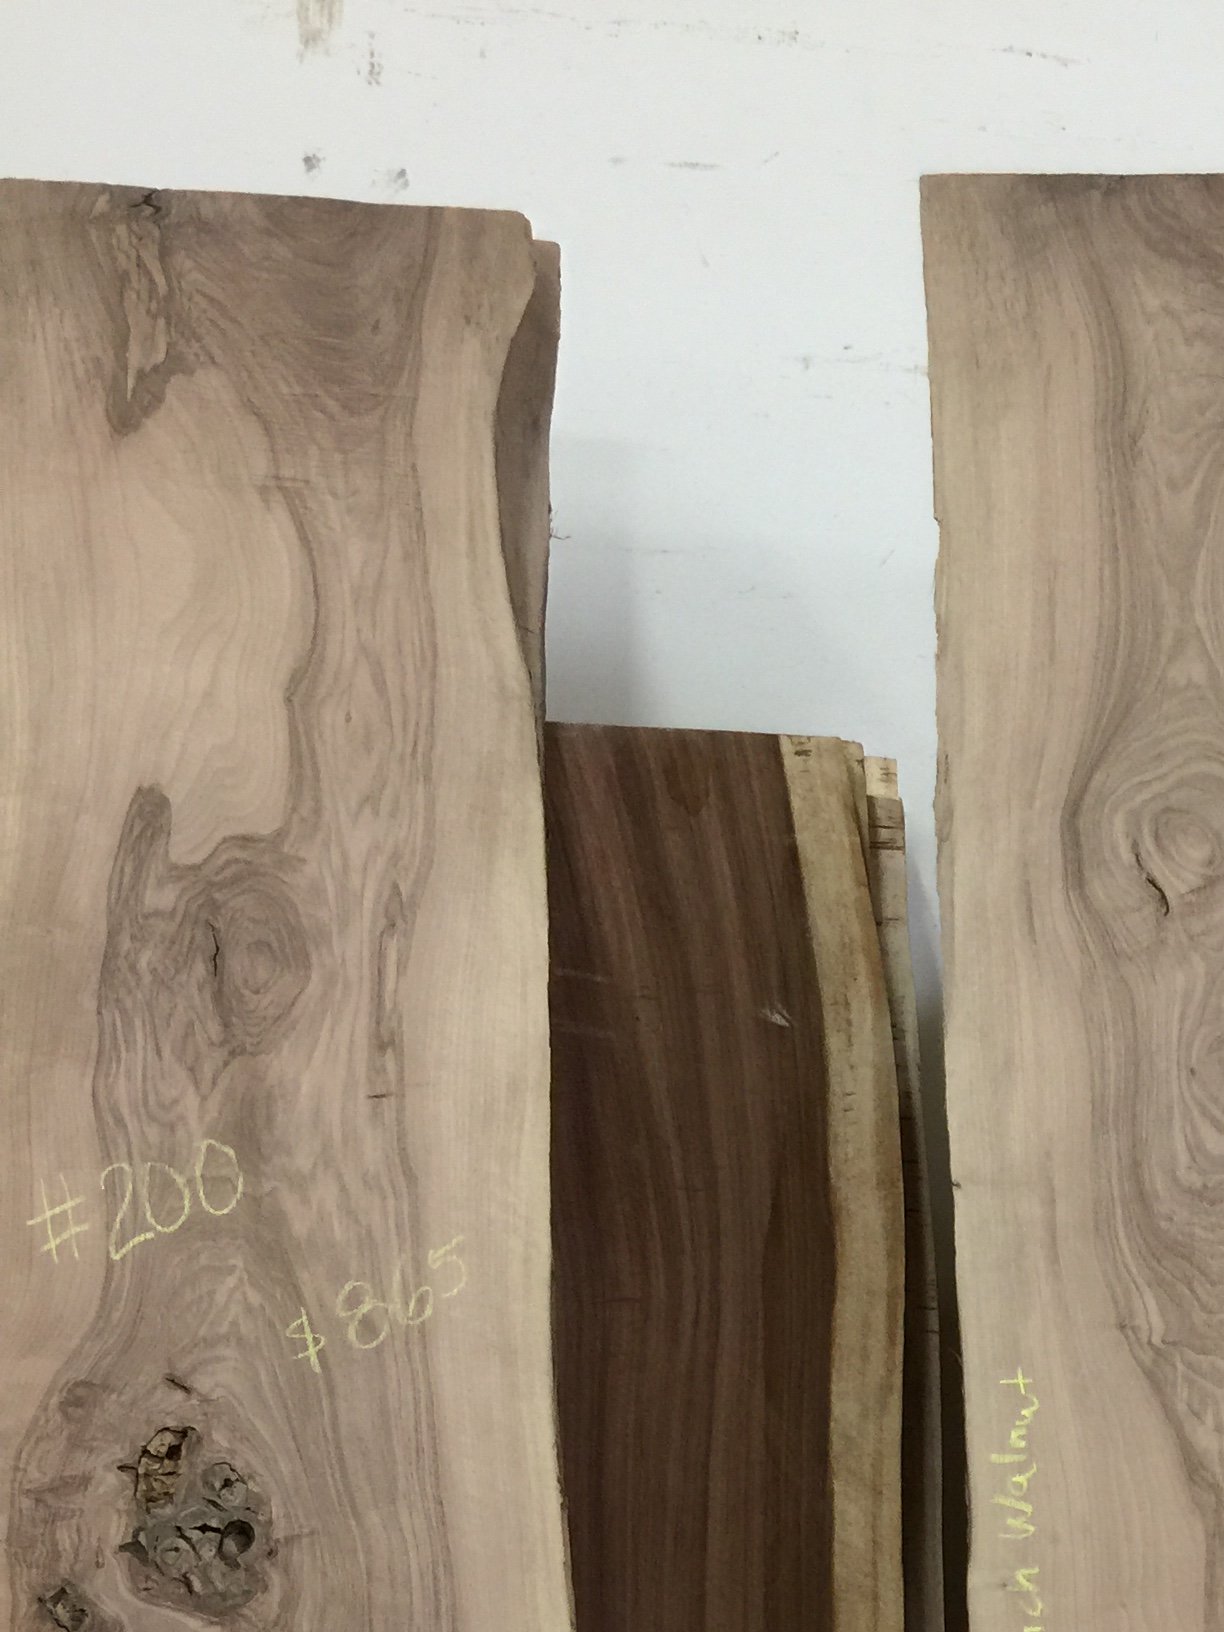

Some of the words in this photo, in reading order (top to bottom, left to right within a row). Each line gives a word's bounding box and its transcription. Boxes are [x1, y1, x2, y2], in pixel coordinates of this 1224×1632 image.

[27, 1139, 243, 1263] #200
[286, 1236, 467, 1373] $865
[991, 1367, 1040, 1540] Walnut
